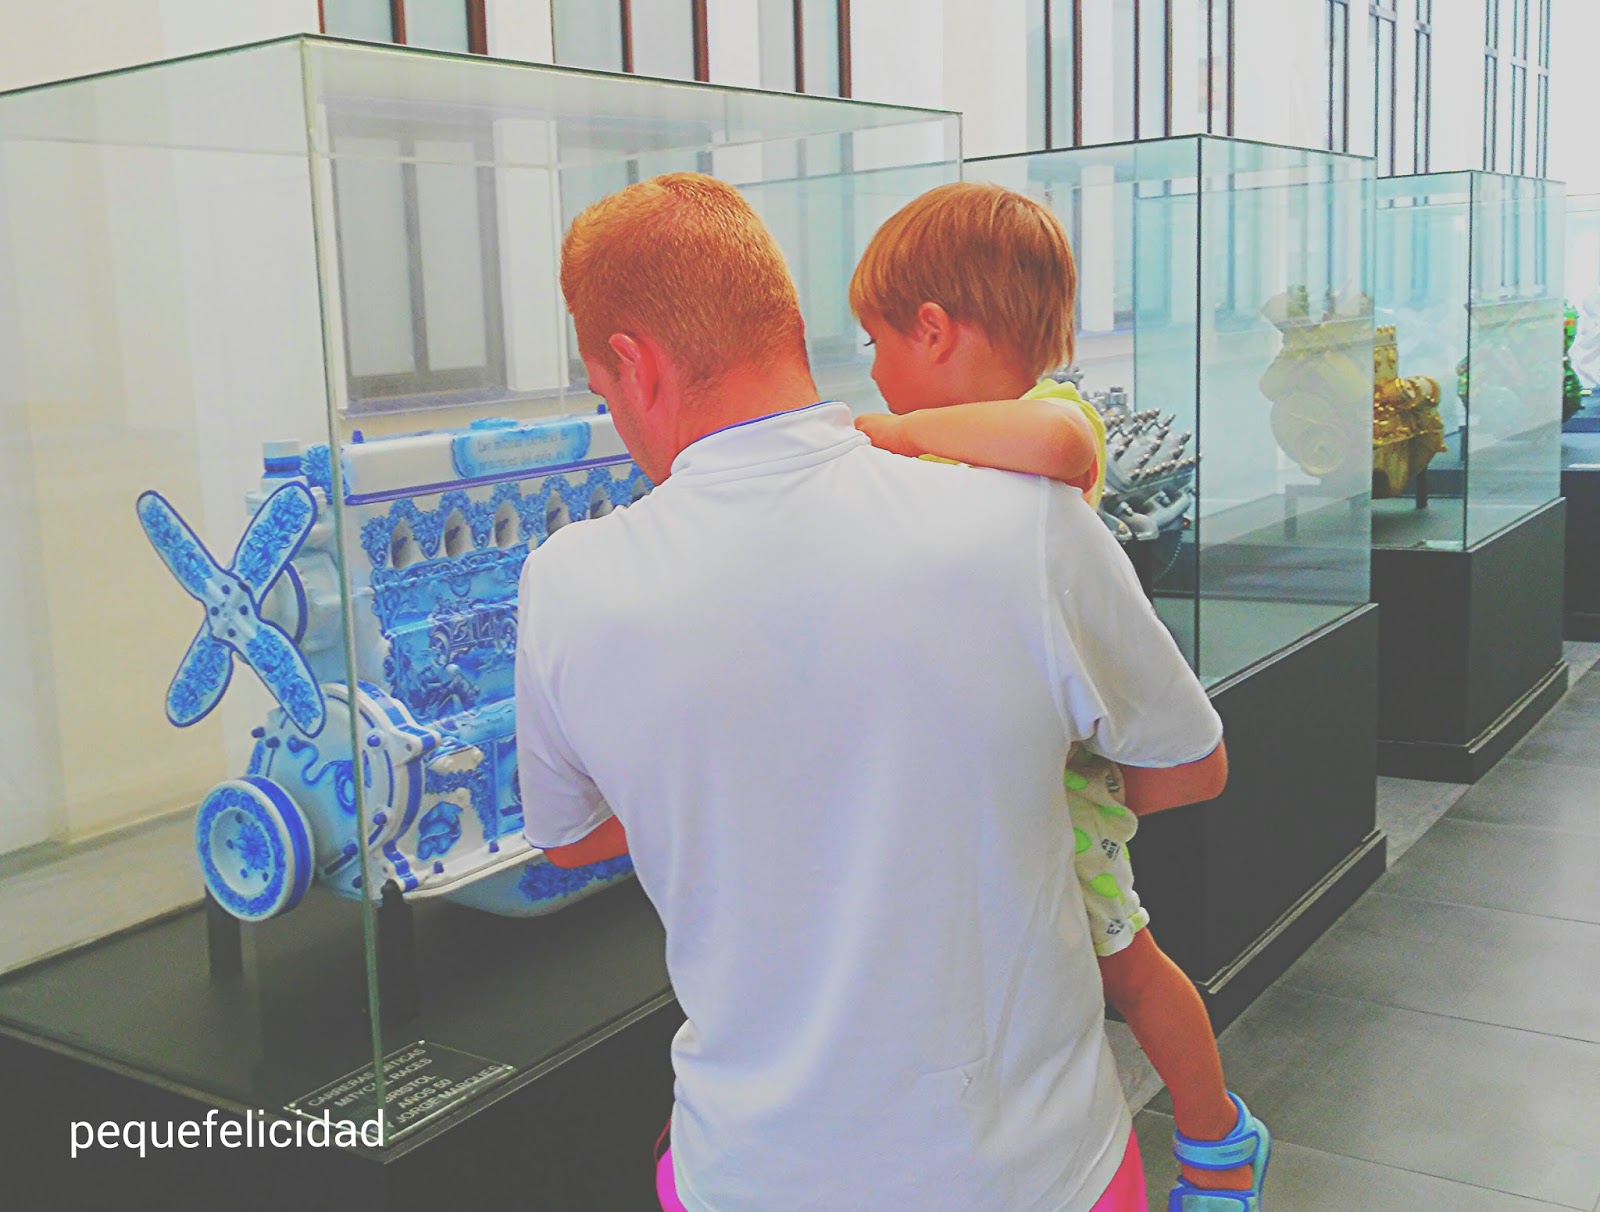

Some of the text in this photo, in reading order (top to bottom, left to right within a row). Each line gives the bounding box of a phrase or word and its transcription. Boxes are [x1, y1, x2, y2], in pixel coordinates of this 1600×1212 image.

[308, 1072, 375, 1106] CARRERAS
[334, 1057, 432, 1107] MITYCL RACES
[396, 1096, 441, 1123] JORGE
